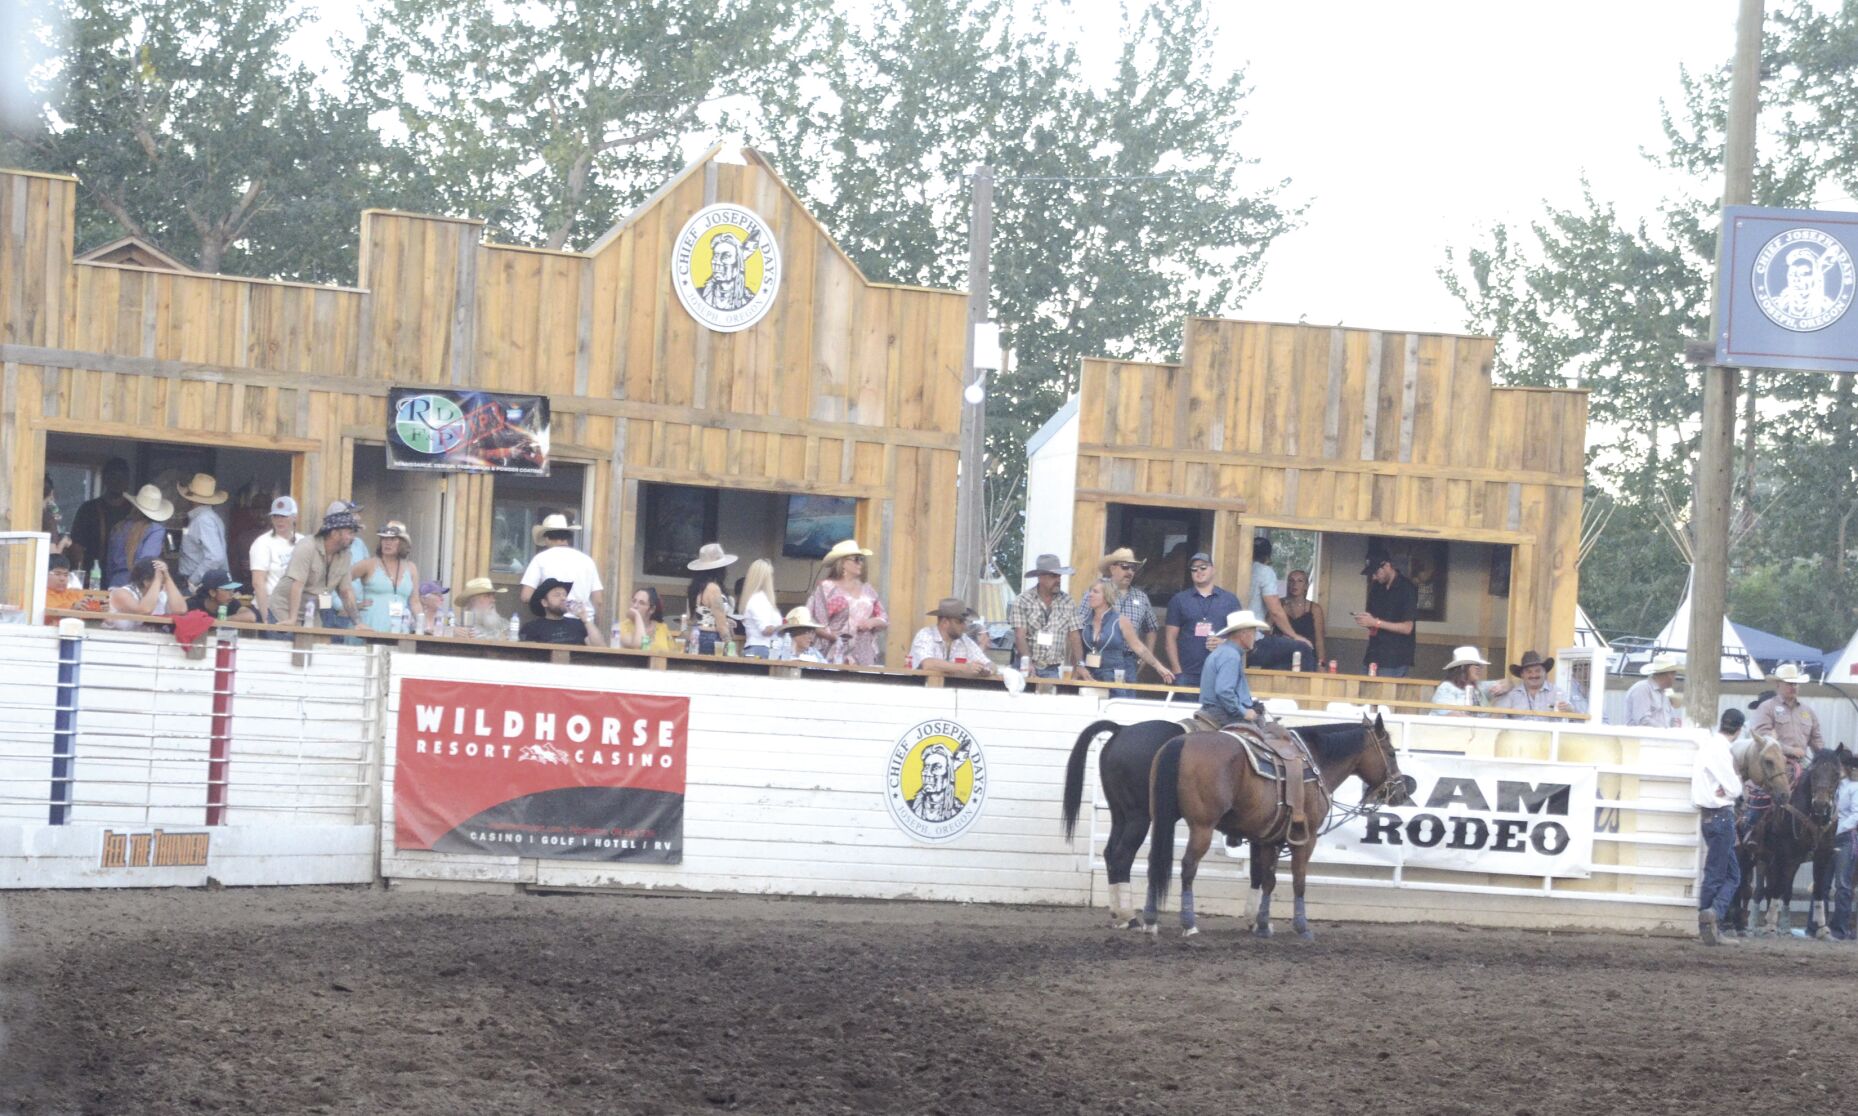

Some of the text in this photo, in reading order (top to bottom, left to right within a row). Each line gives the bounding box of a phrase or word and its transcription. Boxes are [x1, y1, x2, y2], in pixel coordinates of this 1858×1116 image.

[679, 211, 773, 286] CHIEF JOSEPH DAYS
[1757, 238, 1782, 274] CHIEF
[726, 299, 764, 322] OREGON
[1799, 302, 1846, 329] OREGON
[415, 704, 674, 748] WILDHORSE
[416, 739, 673, 769] RESORT CASINO
[890, 722, 984, 795] CHIEF JOSEPH DAYS
[936, 810, 973, 834] OREGON
[1360, 812, 1571, 856] RODEO
[470, 831, 523, 843] CASINO
[541, 836, 576, 846] GOLF
[594, 838, 636, 849] HOTEL
[655, 841, 672, 850] RV
